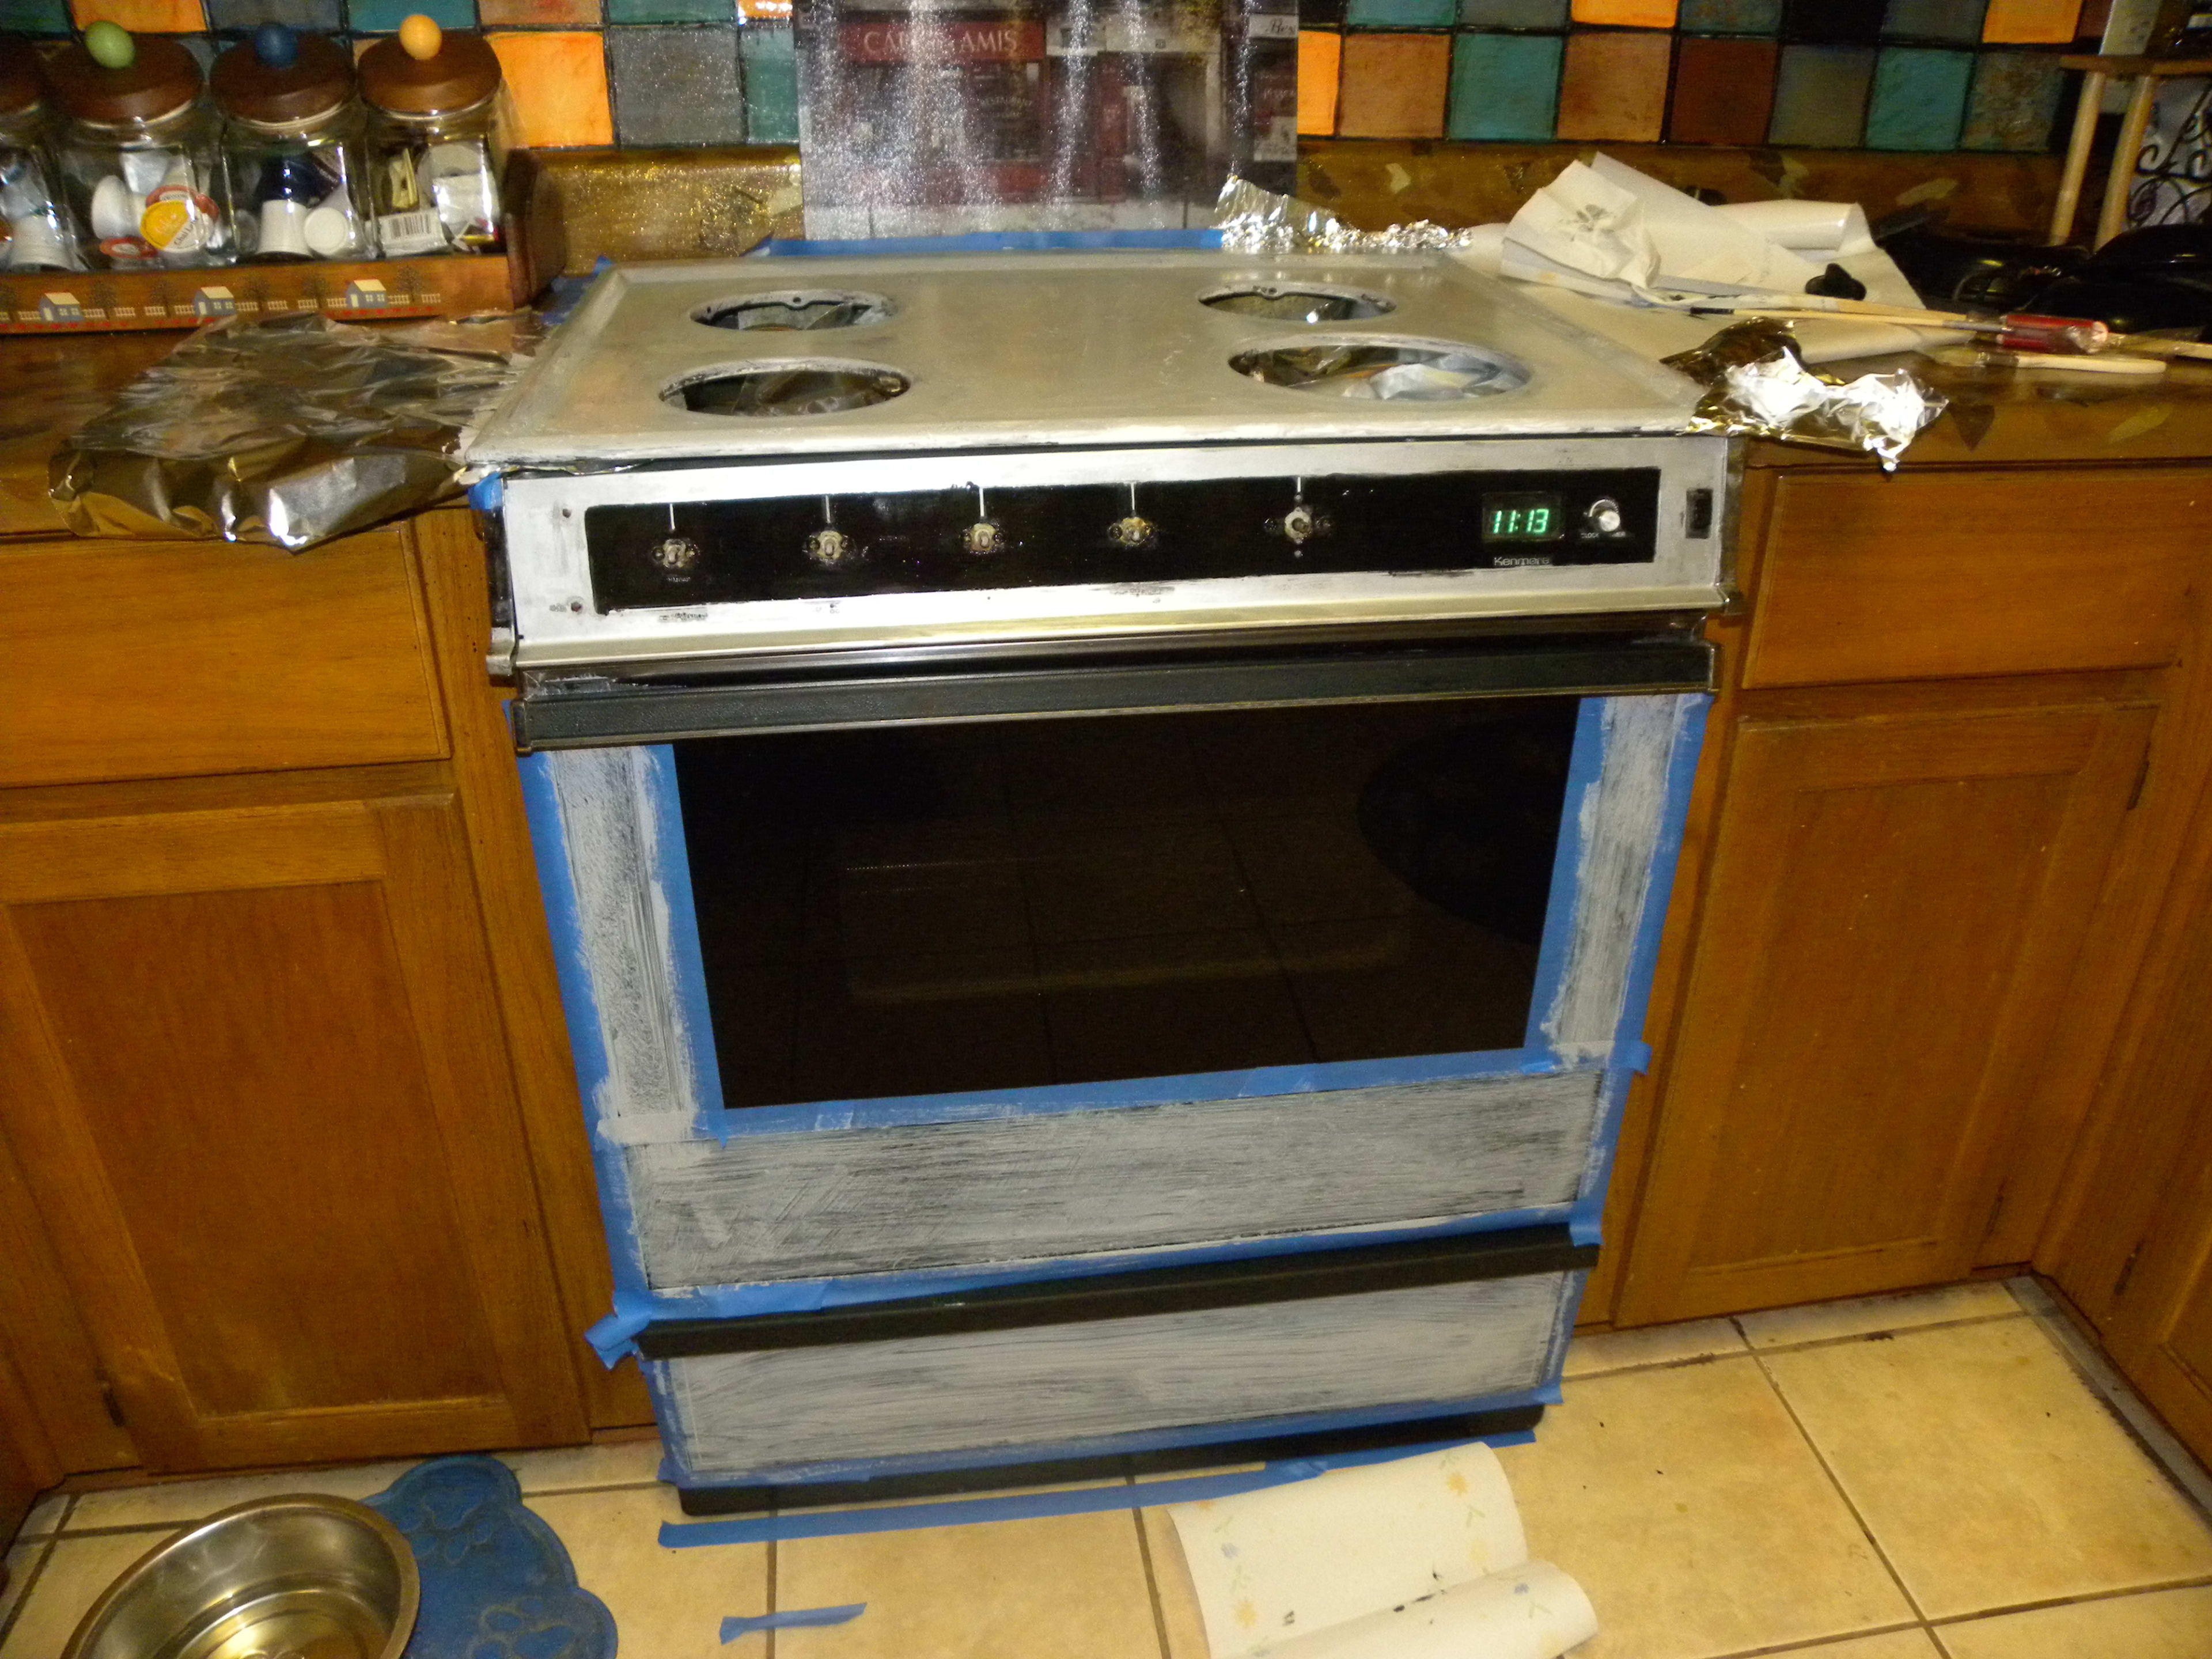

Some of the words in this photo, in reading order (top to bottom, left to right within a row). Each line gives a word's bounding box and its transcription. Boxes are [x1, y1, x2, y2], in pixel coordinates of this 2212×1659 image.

[863, 30, 920, 55] CAF
[960, 30, 1017, 52] AMIS
[1493, 509, 1549, 533] 11:13
[1494, 556, 1549, 566] Kenmore
